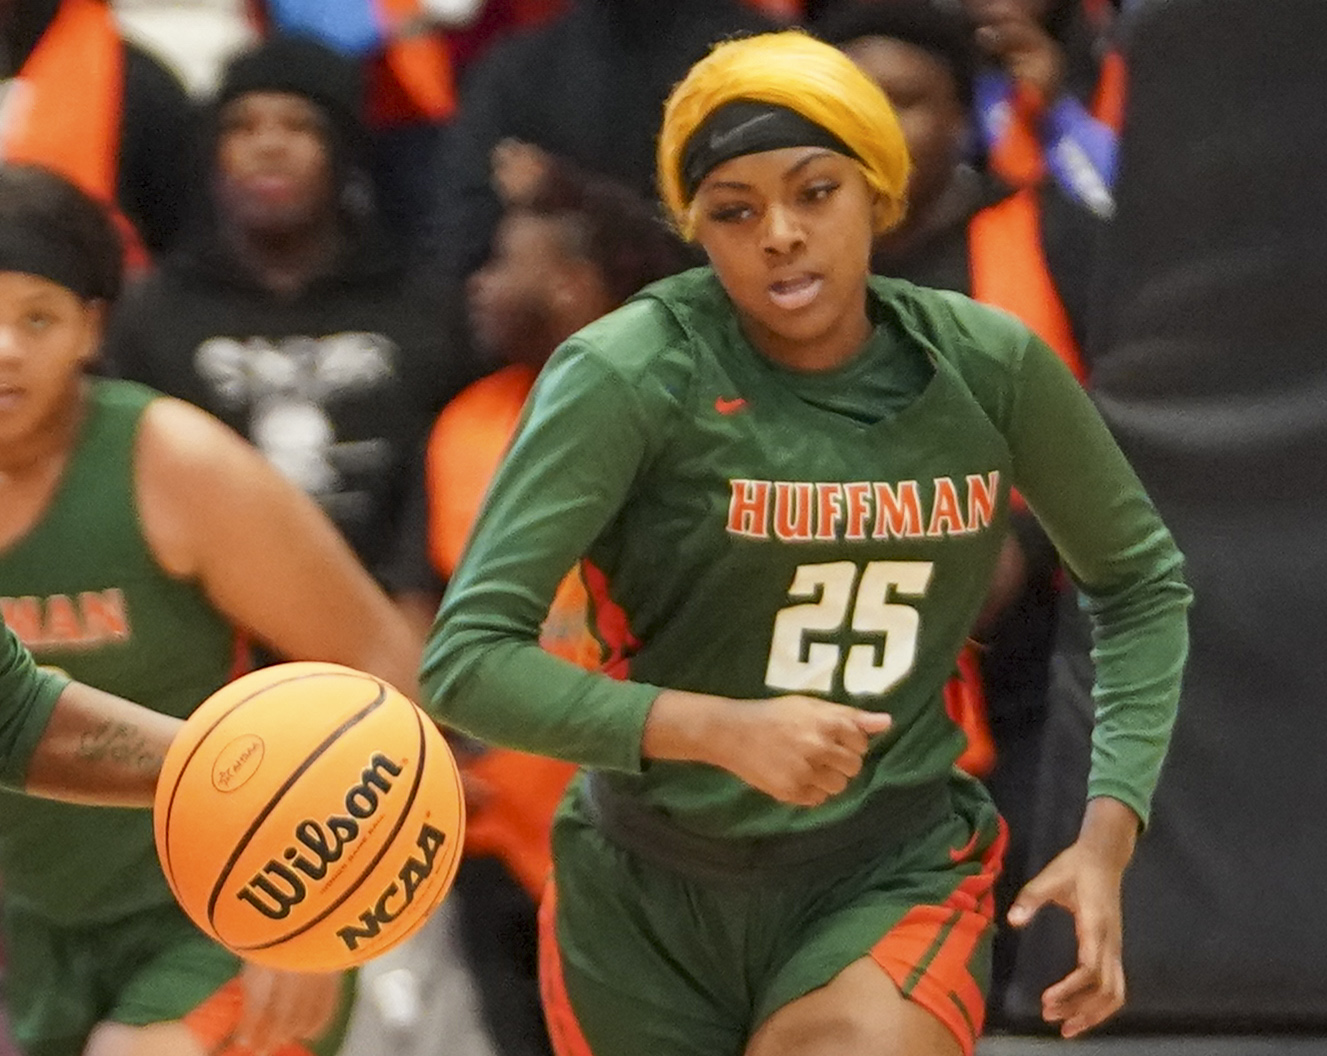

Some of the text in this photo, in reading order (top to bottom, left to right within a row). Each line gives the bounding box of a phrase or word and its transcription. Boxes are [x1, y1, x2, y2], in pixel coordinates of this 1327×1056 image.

[726, 470, 999, 541] HUFFMAN
[764, 560, 934, 697] 25
[237, 753, 402, 920] Wilson
[336, 822, 447, 952] NCAA
